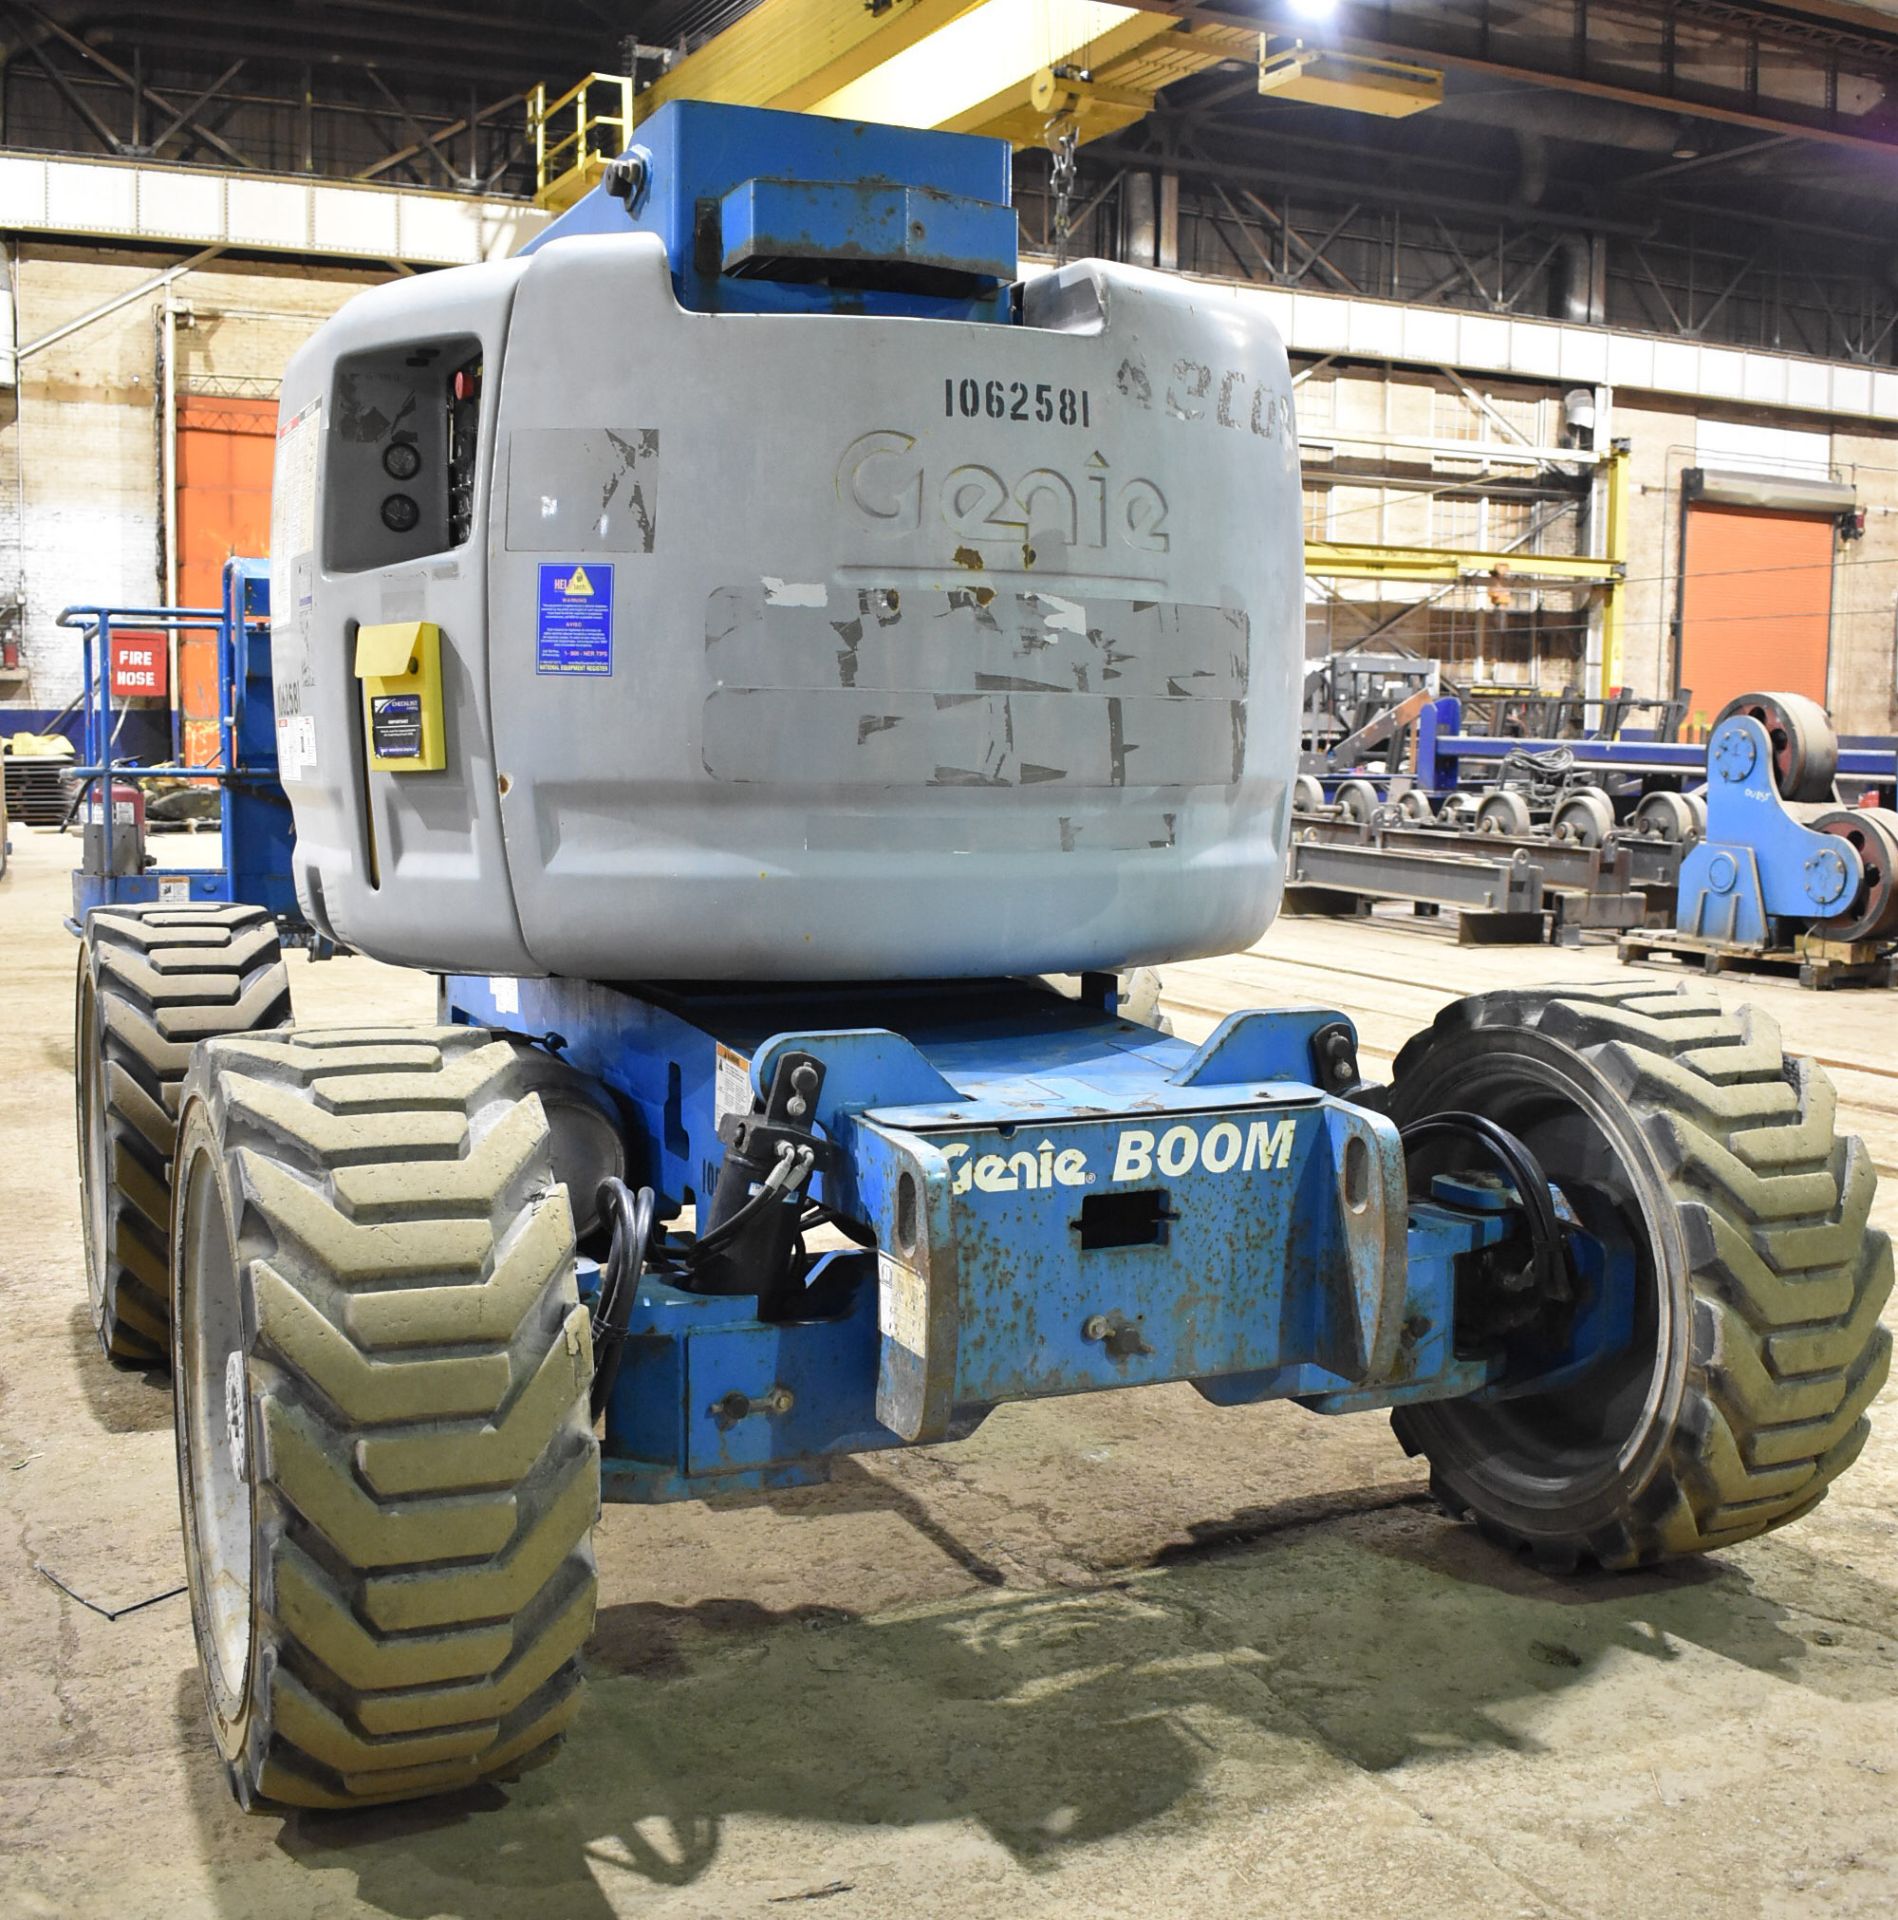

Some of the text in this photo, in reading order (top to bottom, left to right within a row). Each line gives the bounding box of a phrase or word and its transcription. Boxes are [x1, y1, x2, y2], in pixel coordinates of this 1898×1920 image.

[945, 379, 1090, 428] 1062581
[834, 428, 1171, 553] Genie
[117, 671, 156, 687] HOSE
[119, 650, 153, 666] FIRE
[942, 1119, 1297, 1195] Genie BOOM
